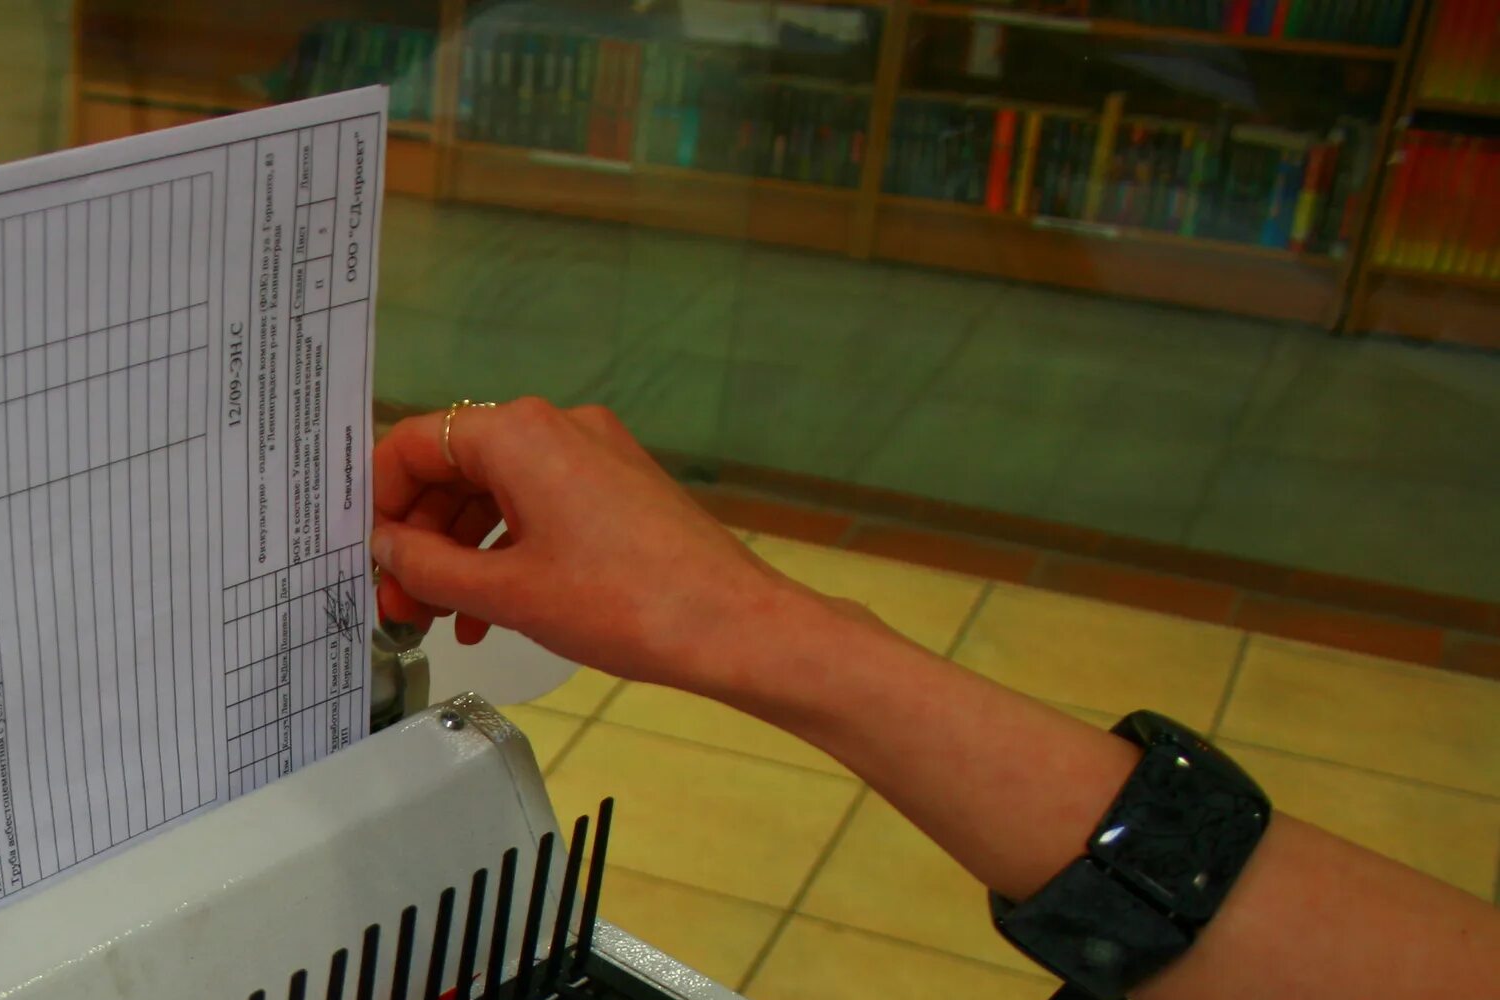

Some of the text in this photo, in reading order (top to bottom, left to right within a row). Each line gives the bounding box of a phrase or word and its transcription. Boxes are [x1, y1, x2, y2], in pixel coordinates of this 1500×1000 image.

[300, 145, 310, 190] Листов
[296, 226, 307, 255] Лист
[346, 242, 358, 283] ООО
[258, 374, 267, 473] оздоровительный
[267, 352, 277, 440] Ленинградском
[304, 337, 312, 434] развлекательный
[313, 380, 321, 426] Ледовая
[304, 444, 312, 534] Оздоровительно
[344, 425, 352, 510] Спецификация
[257, 484, 267, 563] Физкультурно
[8, 850, 22, 886] Труба
